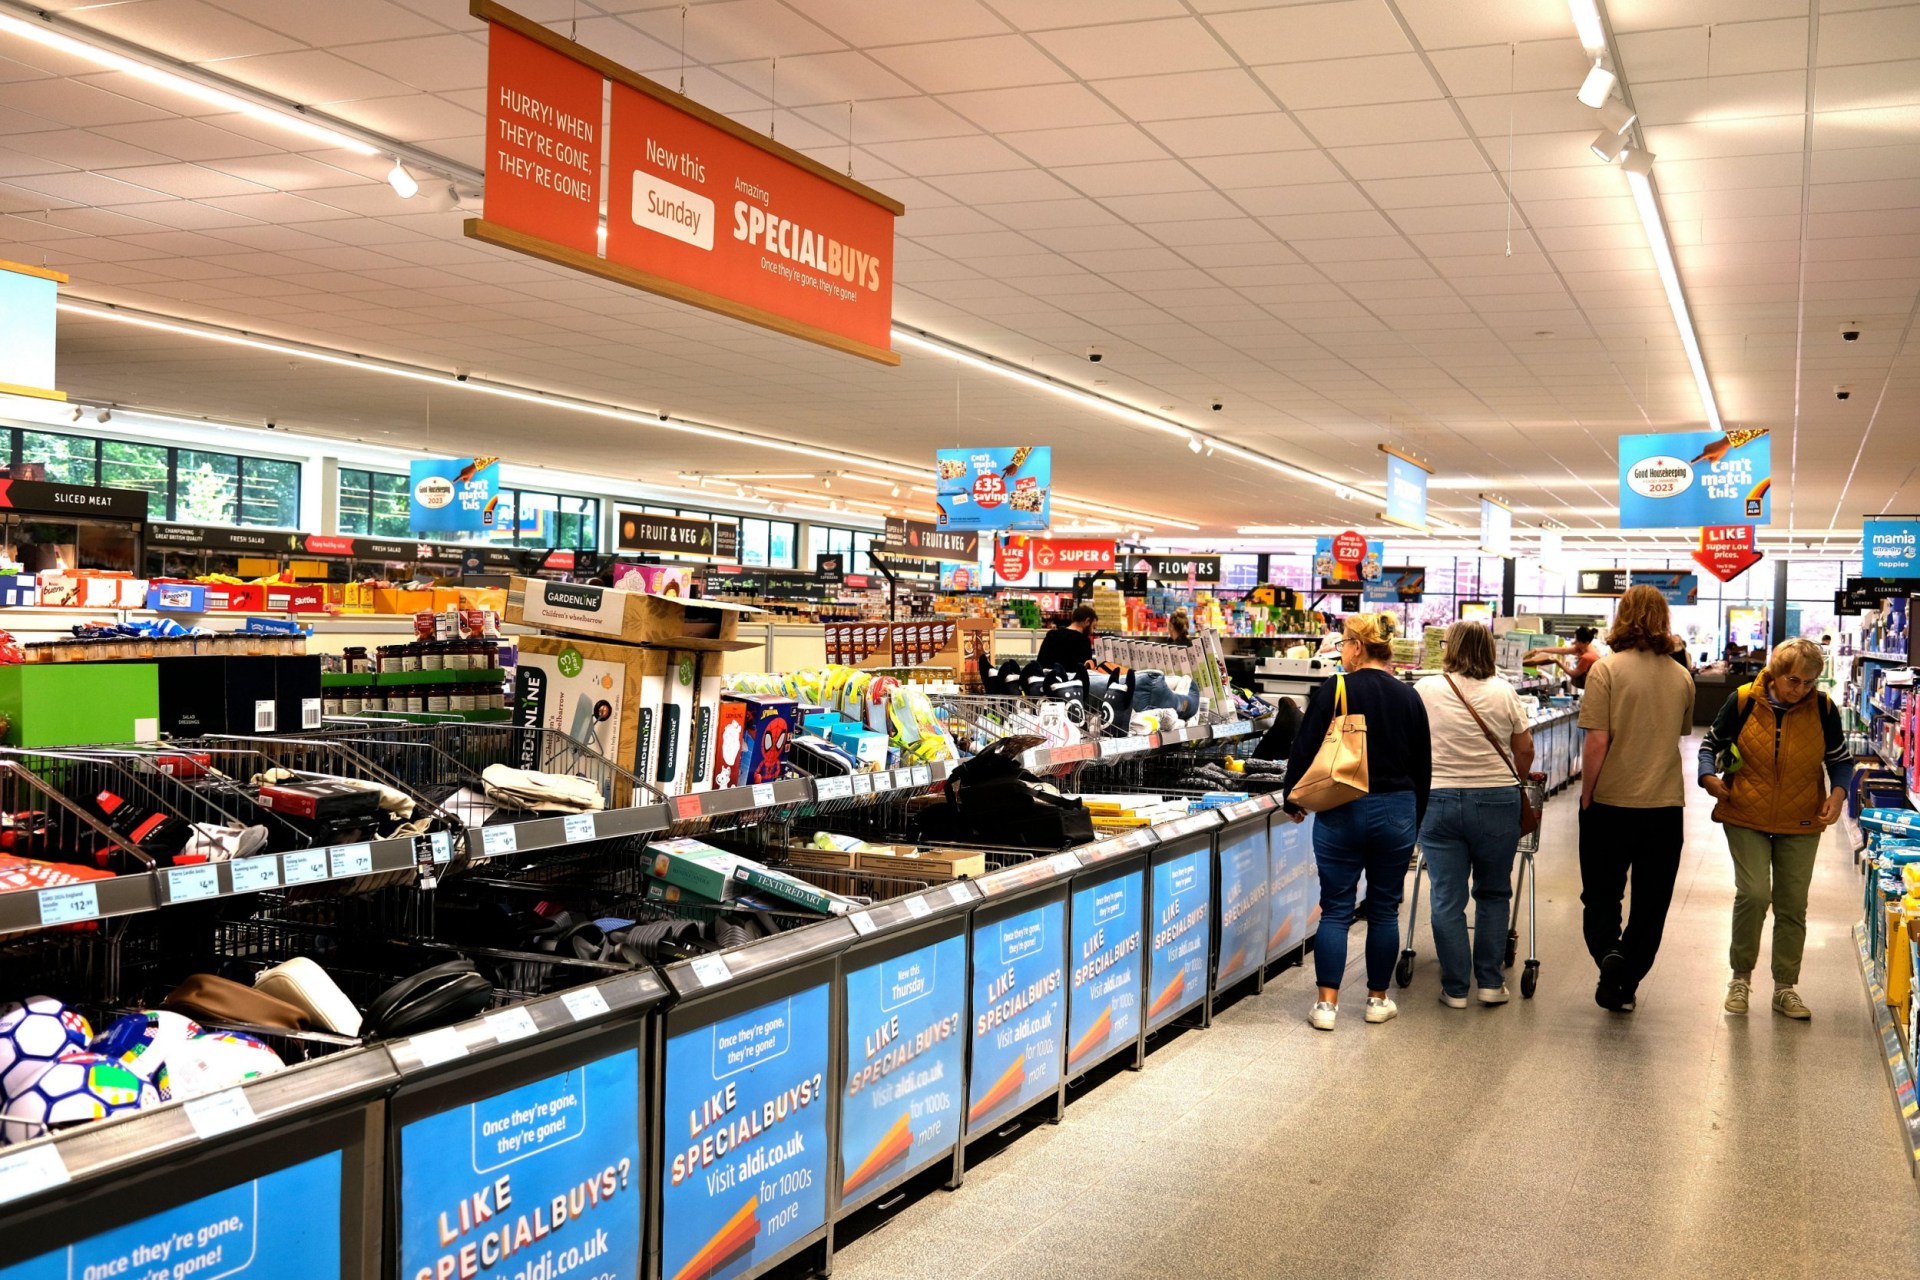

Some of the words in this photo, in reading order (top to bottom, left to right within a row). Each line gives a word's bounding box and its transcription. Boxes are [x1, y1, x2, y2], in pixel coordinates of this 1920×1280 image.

[501, 86, 553, 127] HURRY!
[556, 110, 593, 144] WHEN
[499, 119, 553, 158] THEY'RE
[556, 143, 592, 176] GONE,
[646, 138, 678, 172] New
[680, 153, 705, 184] this
[498, 151, 551, 188] THEY'RE
[554, 173, 591, 203] GONE!
[735, 177, 769, 207] Amazing
[648, 190, 701, 236] Sunday
[734, 200, 880, 292] SPECIALBUYS
[761, 257, 778, 274] Once
[778, 263, 800, 282] they're
[801, 270, 819, 290] gone,
[819, 277, 840, 296] they're
[840, 286, 857, 303] gone!
[975, 478, 1001, 492] £35
[1634, 468, 1649, 479] Good
[1650, 467, 1687, 479] Housekeeping
[1650, 484, 1674, 492] 2023
[1701, 472, 1752, 486] match
[55, 493, 86, 504] SLICED
[89, 496, 112, 506] MEAT
[973, 492, 1009, 504] saving
[1708, 484, 1738, 499] this
[640, 524, 668, 541] FRUIT
[670, 528, 677, 543] &
[680, 528, 697, 544] VEG
[922, 532, 943, 548] FRUIT
[944, 534, 950, 549] &
[951, 536, 965, 551] VEG
[1705, 544, 1731, 552] super
[1709, 528, 1747, 542] LIKE
[1873, 530, 1916, 544] mamia
[1002, 548, 1024, 557] LIKE
[1060, 550, 1099, 561] SUPER
[1101, 550, 1110, 561] 6
[1159, 562, 1214, 575] FLOWRS
[1340, 548, 1360, 558] £20
[1714, 551, 1739, 560] prices.
[43, 586, 65, 595] bueno
[294, 597, 317, 605] Skittles
[548, 592, 597, 607] GARDENLINE
[542, 610, 568, 620] Children's
[569, 614, 603, 624] wheelbarrow
[521, 676, 541, 771] ARDENLINE
[556, 692, 565, 743] weelbarrow
[545, 716, 555, 756] Childn's
[639, 713, 650, 783] GARDENLINE
[668, 720, 677, 768] GARDENLINE
[698, 712, 709, 777] GARDENLINE
[200, 880, 214, 889] £4.99
[261, 871, 274, 881] £2.99
[757, 874, 804, 899] TEXTURED
[802, 892, 823, 906] ART
[71, 900, 93, 911] £12.99
[1163, 899, 1180, 927] LIKE
[1155, 902, 1208, 952] SPECIALBUYS?
[1075, 931, 1140, 989] SPECIALBUYS?
[1083, 928, 1104, 961] LIKE
[892, 977, 925, 1001] Thursday
[898, 969, 909, 982] New
[910, 964, 920, 976] this
[988, 967, 1016, 1005] LIKE
[977, 968, 1061, 1038] SPECIALBUYS?
[719, 1035, 737, 1050] Once
[738, 1024, 763, 1044] they're
[764, 1017, 785, 1036] gone,
[866, 1014, 899, 1060] LIKE
[996, 1026, 1013, 1050] Visit
[1014, 1011, 1052, 1042] aldi.co.uk
[727, 1044, 754, 1065] they're
[755, 1036, 776, 1058] gone!
[850, 1012, 959, 1097] SPECIALBUYS?
[872, 1083, 894, 1110] Visit
[894, 1060, 944, 1099] aldi.co.uk
[482, 1118, 509, 1137] Once
[511, 1104, 548, 1128] they're
[549, 1093, 577, 1114] gone,
[690, 1082, 737, 1139] LIKE
[910, 1101, 924, 1119] for
[926, 1091, 950, 1114] 1000s
[498, 1129, 535, 1154] they're
[537, 1117, 566, 1143] gone!
[671, 1073, 822, 1186] SPECIALBUYS?
[918, 1120, 941, 1147] more
[706, 1163, 736, 1197] Visit
[738, 1131, 805, 1183] aldi.co.uk
[760, 1180, 778, 1204] for
[780, 1168, 812, 1198] 1000s
[439, 1174, 512, 1248] LIKE
[768, 1201, 800, 1236] more
[83, 1257, 128, 1280] Once
[132, 1234, 194, 1268] they're
[197, 1215, 244, 1247] gone,
[173, 1246, 223, 1280] gone!
